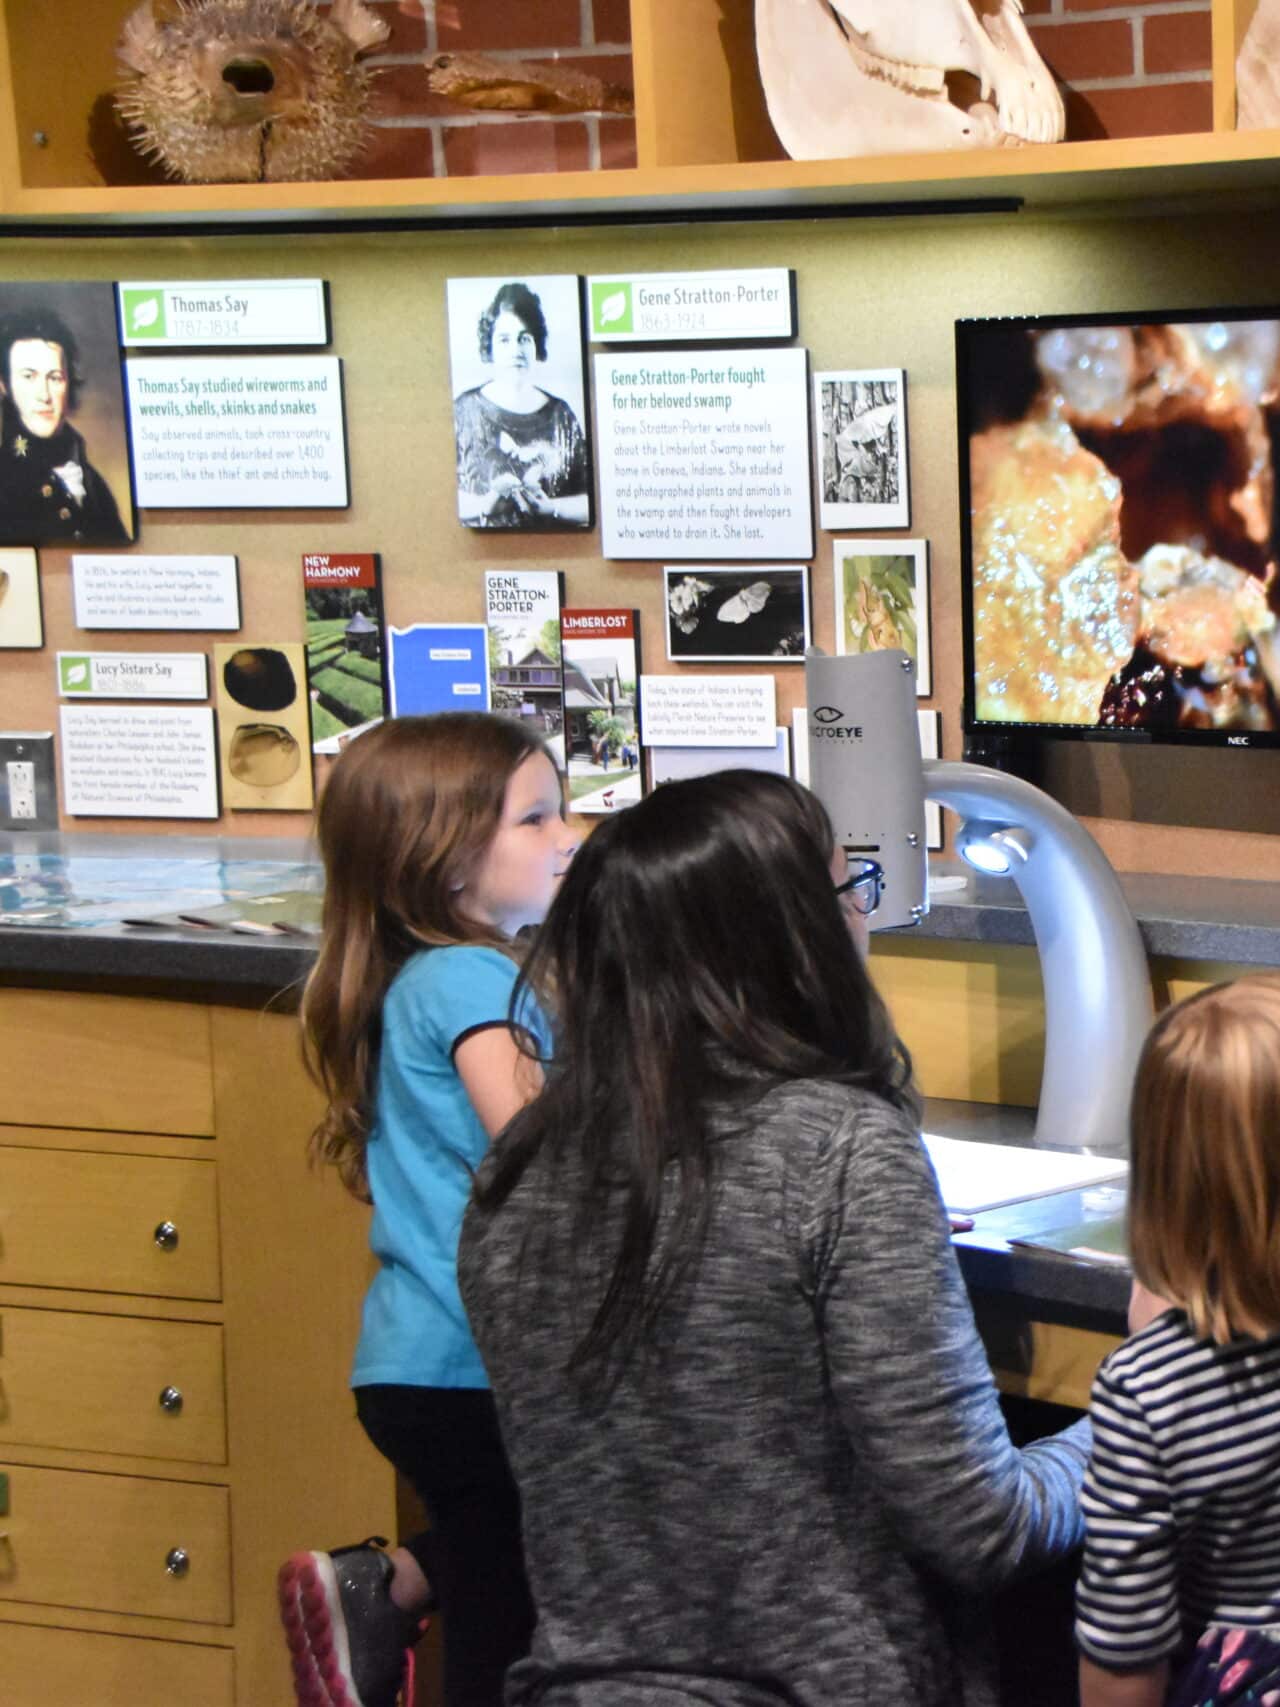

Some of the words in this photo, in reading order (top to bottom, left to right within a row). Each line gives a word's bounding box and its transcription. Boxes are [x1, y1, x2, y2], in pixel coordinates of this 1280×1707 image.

[639, 288, 671, 306] Gene
[674, 285, 779, 304] Stratton-Porter
[171, 296, 223, 313] Thomas
[225, 295, 249, 317] Say
[174, 319, 240, 337] 1787-1834
[611, 369, 638, 385] Gene
[640, 368, 725, 385] Stratton-Porter
[727, 366, 766, 389] fought
[138, 378, 179, 393] Thomas
[181, 377, 200, 398] Say
[202, 377, 243, 393] studied
[246, 377, 306, 392] wireworms
[308, 376, 328, 392] and
[139, 400, 184, 418] weevils,
[185, 400, 220, 418] shells,
[221, 400, 256, 416] skinks
[258, 400, 278, 415] and
[280, 399, 317, 415] snakes
[612, 392, 628, 409] for
[631, 392, 647, 408] her
[650, 392, 691, 408] beloved
[694, 395, 732, 413] swamp
[614, 420, 636, 434] Gene
[715, 421, 741, 432] wrote
[744, 418, 772, 432] novels
[141, 427, 159, 443] Say
[162, 428, 202, 440] observed
[245, 428, 264, 440] took
[143, 447, 184, 463] collecting
[187, 449, 208, 462] trips
[211, 448, 228, 460] and
[230, 447, 273, 460] described
[276, 450, 294, 460] over
[298, 445, 325, 460] 1,400
[614, 442, 638, 455] about
[642, 441, 656, 455] the
[660, 441, 707, 455] Limberlost
[710, 440, 743, 457] Swamp
[747, 444, 766, 455] near
[770, 441, 784, 455] her
[180, 467, 196, 480] like
[199, 467, 214, 480] the
[218, 467, 241, 480] thief
[245, 468, 260, 480] ant
[262, 467, 278, 480] and
[281, 466, 311, 480] chinch
[615, 464, 638, 476] home
[642, 464, 650, 476] in
[729, 461, 746, 476] She
[749, 463, 783, 476] studied
[616, 483, 631, 496] and
[634, 483, 694, 500] photographed
[697, 483, 724, 499] plants
[727, 482, 743, 496] and
[746, 482, 780, 496] animals
[783, 484, 792, 496] in
[617, 505, 631, 518] the
[634, 507, 664, 520] swamp
[667, 505, 683, 518] and
[686, 505, 707, 518] then
[710, 504, 740, 521] fought
[743, 504, 792, 520] developers
[618, 525, 635, 538] who
[638, 525, 670, 538] wanted
[673, 526, 682, 538] to
[685, 525, 707, 538] drain
[723, 524, 741, 538] She
[304, 556, 330, 567] NEW
[305, 566, 360, 577] HARMONY
[488, 577, 519, 588] GENE
[488, 589, 550, 601] STRATTON-
[489, 601, 533, 613] PORTER
[563, 616, 627, 628] LIMBERLOST
[96, 662, 118, 676] Lucy
[119, 662, 153, 674] Sistare
[155, 662, 172, 678] Say
[1228, 736, 1249, 746] NEC
